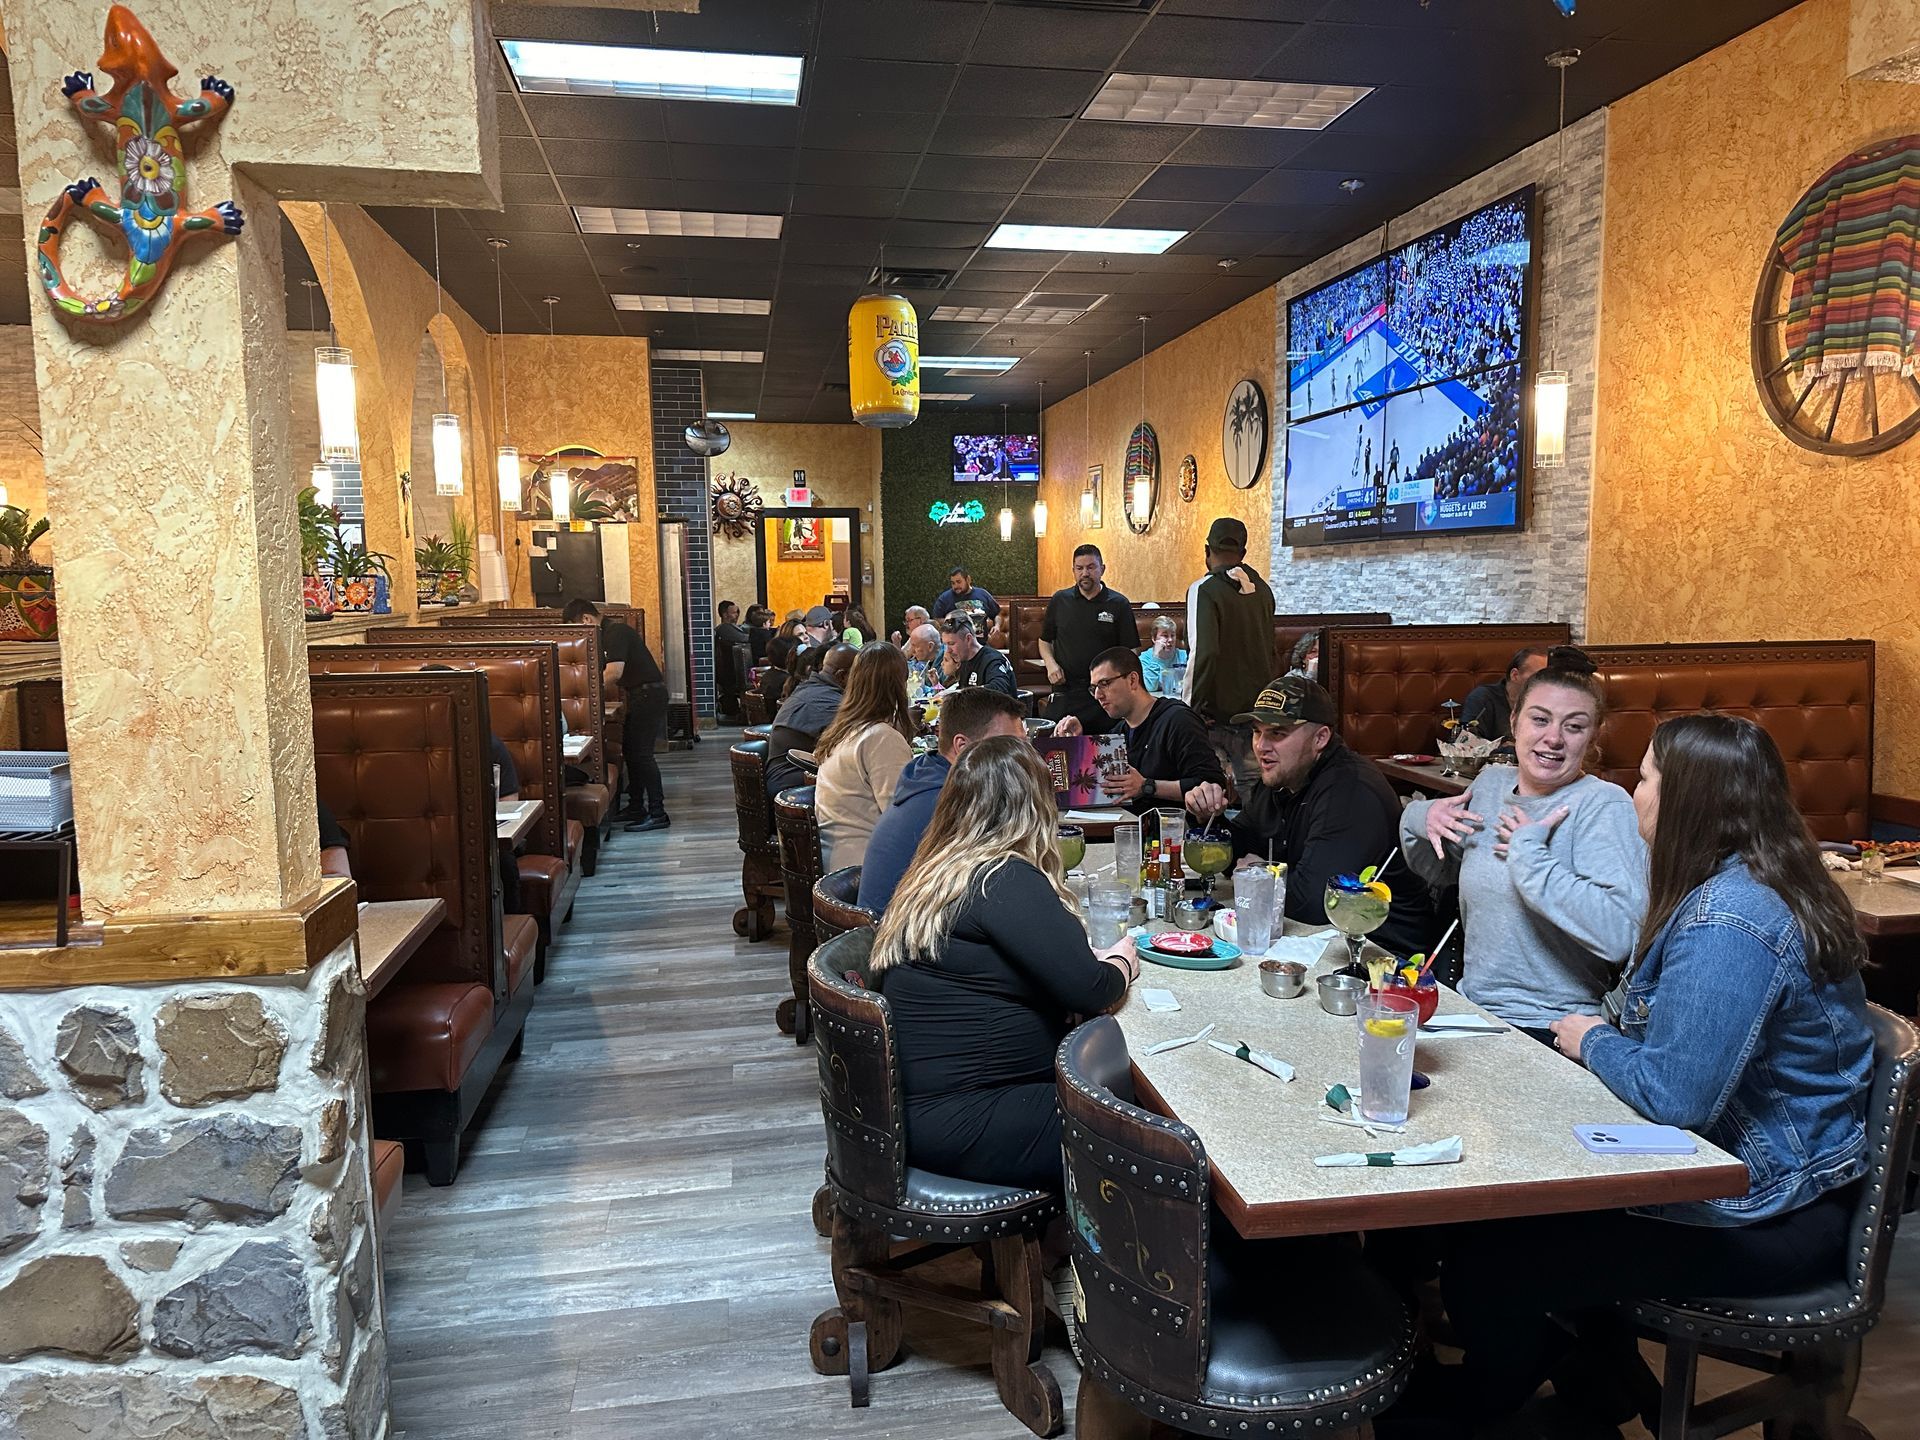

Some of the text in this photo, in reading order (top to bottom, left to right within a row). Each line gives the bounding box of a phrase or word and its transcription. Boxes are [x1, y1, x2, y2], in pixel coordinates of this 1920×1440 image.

[1363, 490, 1375, 504] 41
[1389, 488, 1399, 500] 68
[1440, 503, 1461, 513] NUGGETS
[1468, 501, 1487, 510] LAKERS
[1053, 754, 1064, 787] Palmas
